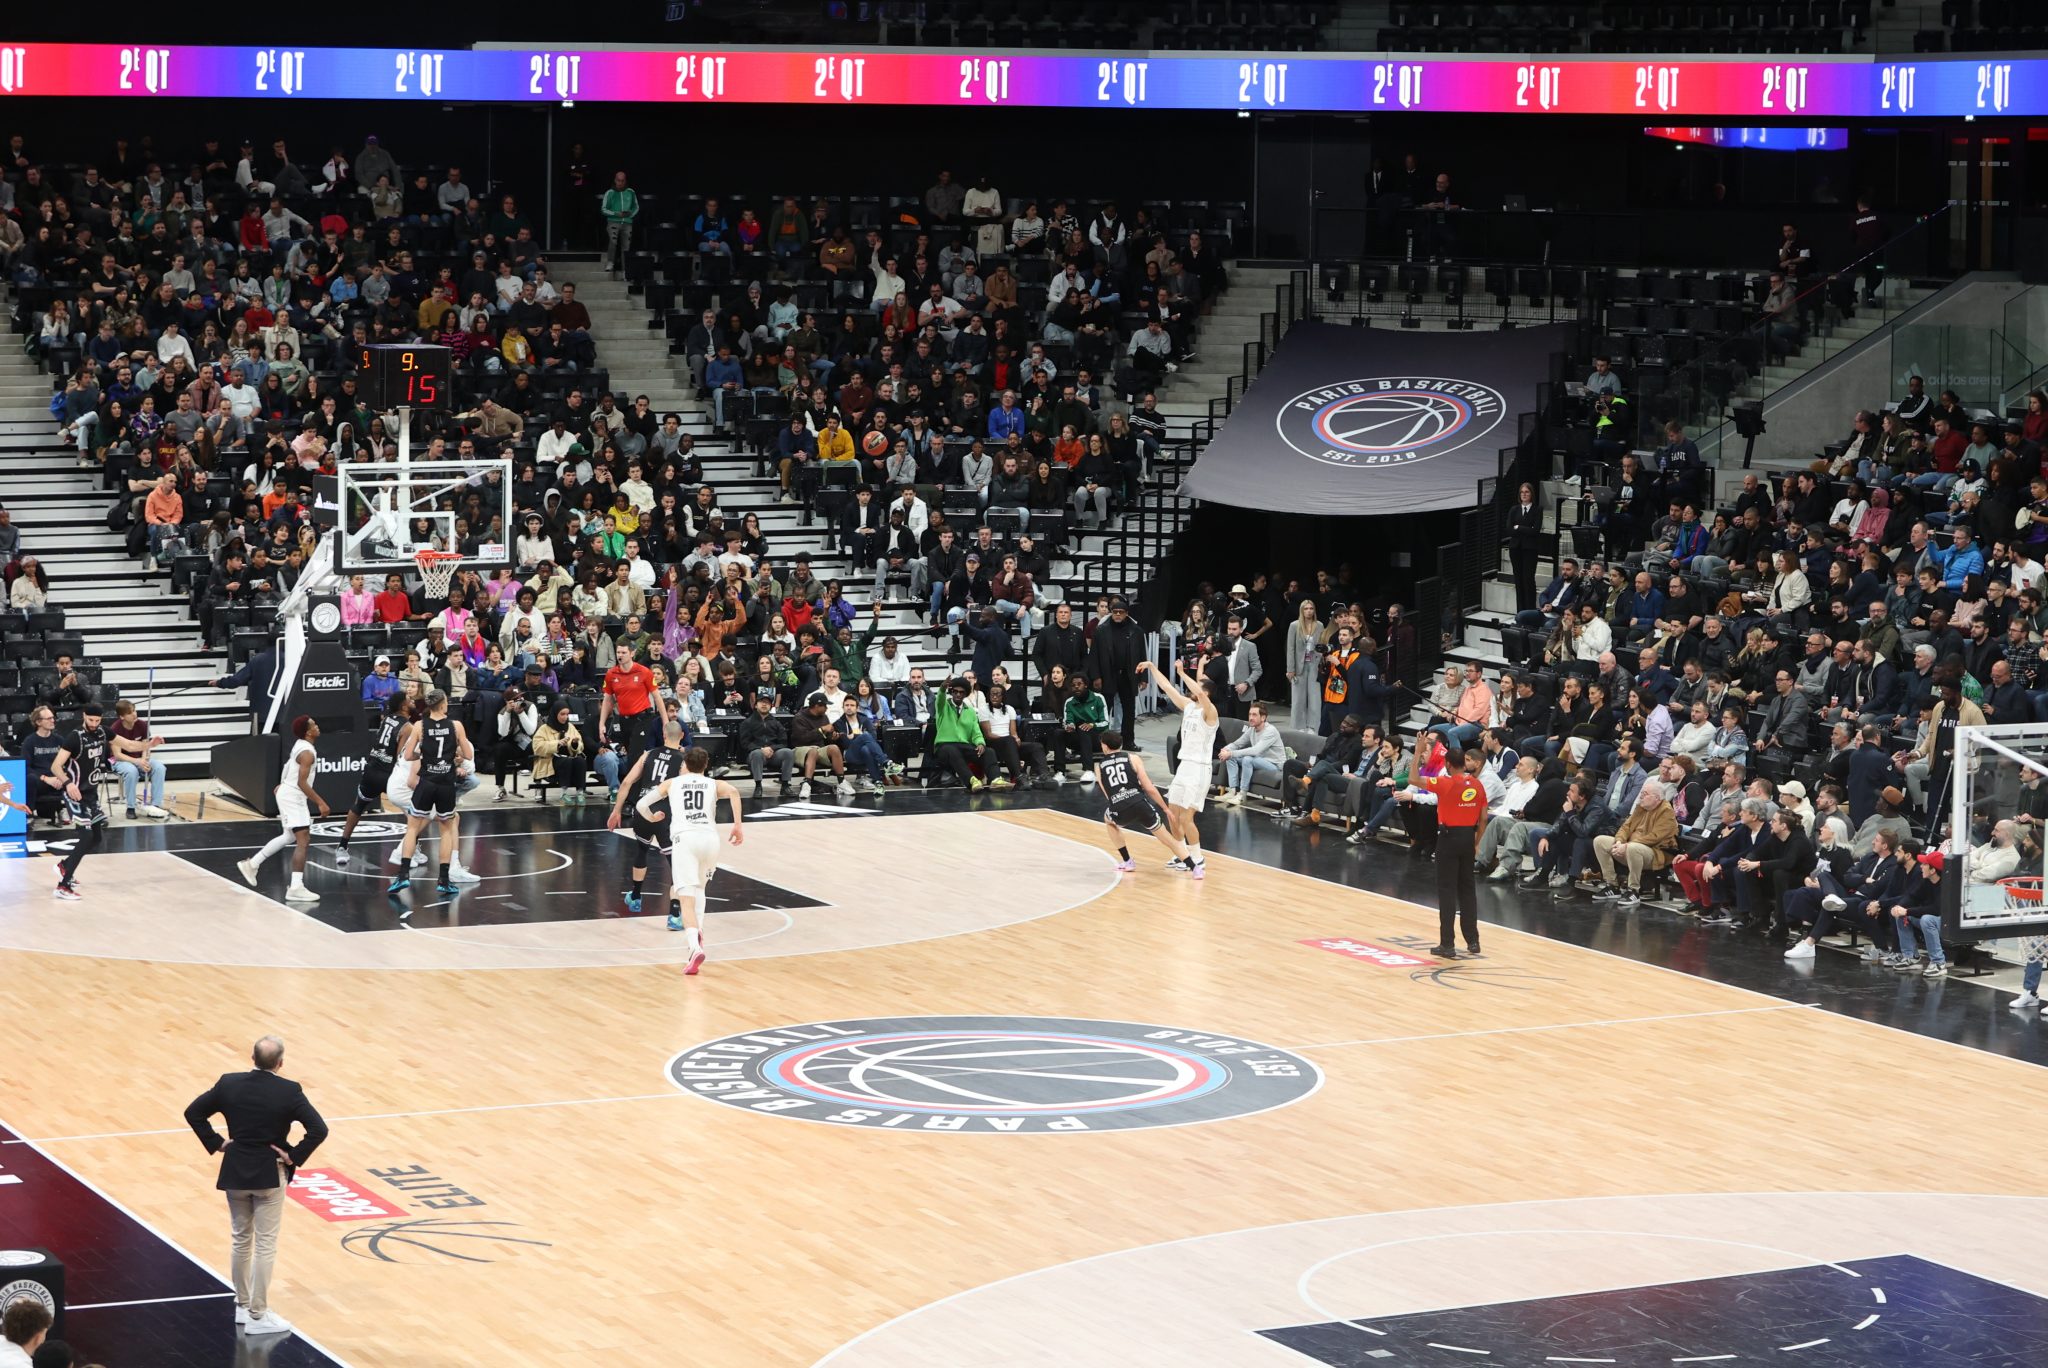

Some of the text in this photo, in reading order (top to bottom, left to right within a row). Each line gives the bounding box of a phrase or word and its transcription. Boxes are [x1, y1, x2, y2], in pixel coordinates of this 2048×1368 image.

[0, 47, 26, 92] QT
[145, 50, 170, 94] QT
[280, 51, 305, 95] QT
[419, 53, 444, 97] QT
[555, 55, 581, 99] QT
[701, 57, 727, 99] QT
[840, 58, 865, 101] QT
[985, 60, 1010, 103] QT
[1123, 62, 1148, 105] QT
[1263, 63, 1288, 107] QT
[1398, 65, 1423, 109] QT
[1539, 67, 1561, 110] QT
[1657, 67, 1679, 111] QT
[1785, 67, 1808, 113] QT
[1898, 67, 1916, 113] QT
[1993, 65, 2011, 113] QT
[408, 375, 436, 403] 15
[1295, 380, 1498, 417] PARIS BASKETBALL
[1322, 450, 1417, 464] EST. 2018
[306, 676, 346, 688] Betclic
[379, 724, 394, 747] 15
[435, 737, 445, 759] 7
[316, 756, 368, 773] ibullet
[651, 759, 669, 782] 14
[1105, 763, 1128, 788] 26
[683, 790, 704, 811] 20
[1144, 1030, 1261, 1055] 2018
[680, 1024, 1090, 1132] PARIS BASKETBALL
[288, 1172, 389, 1216] Betclic
[12, 1281, 53, 1307] BASKETBALL
